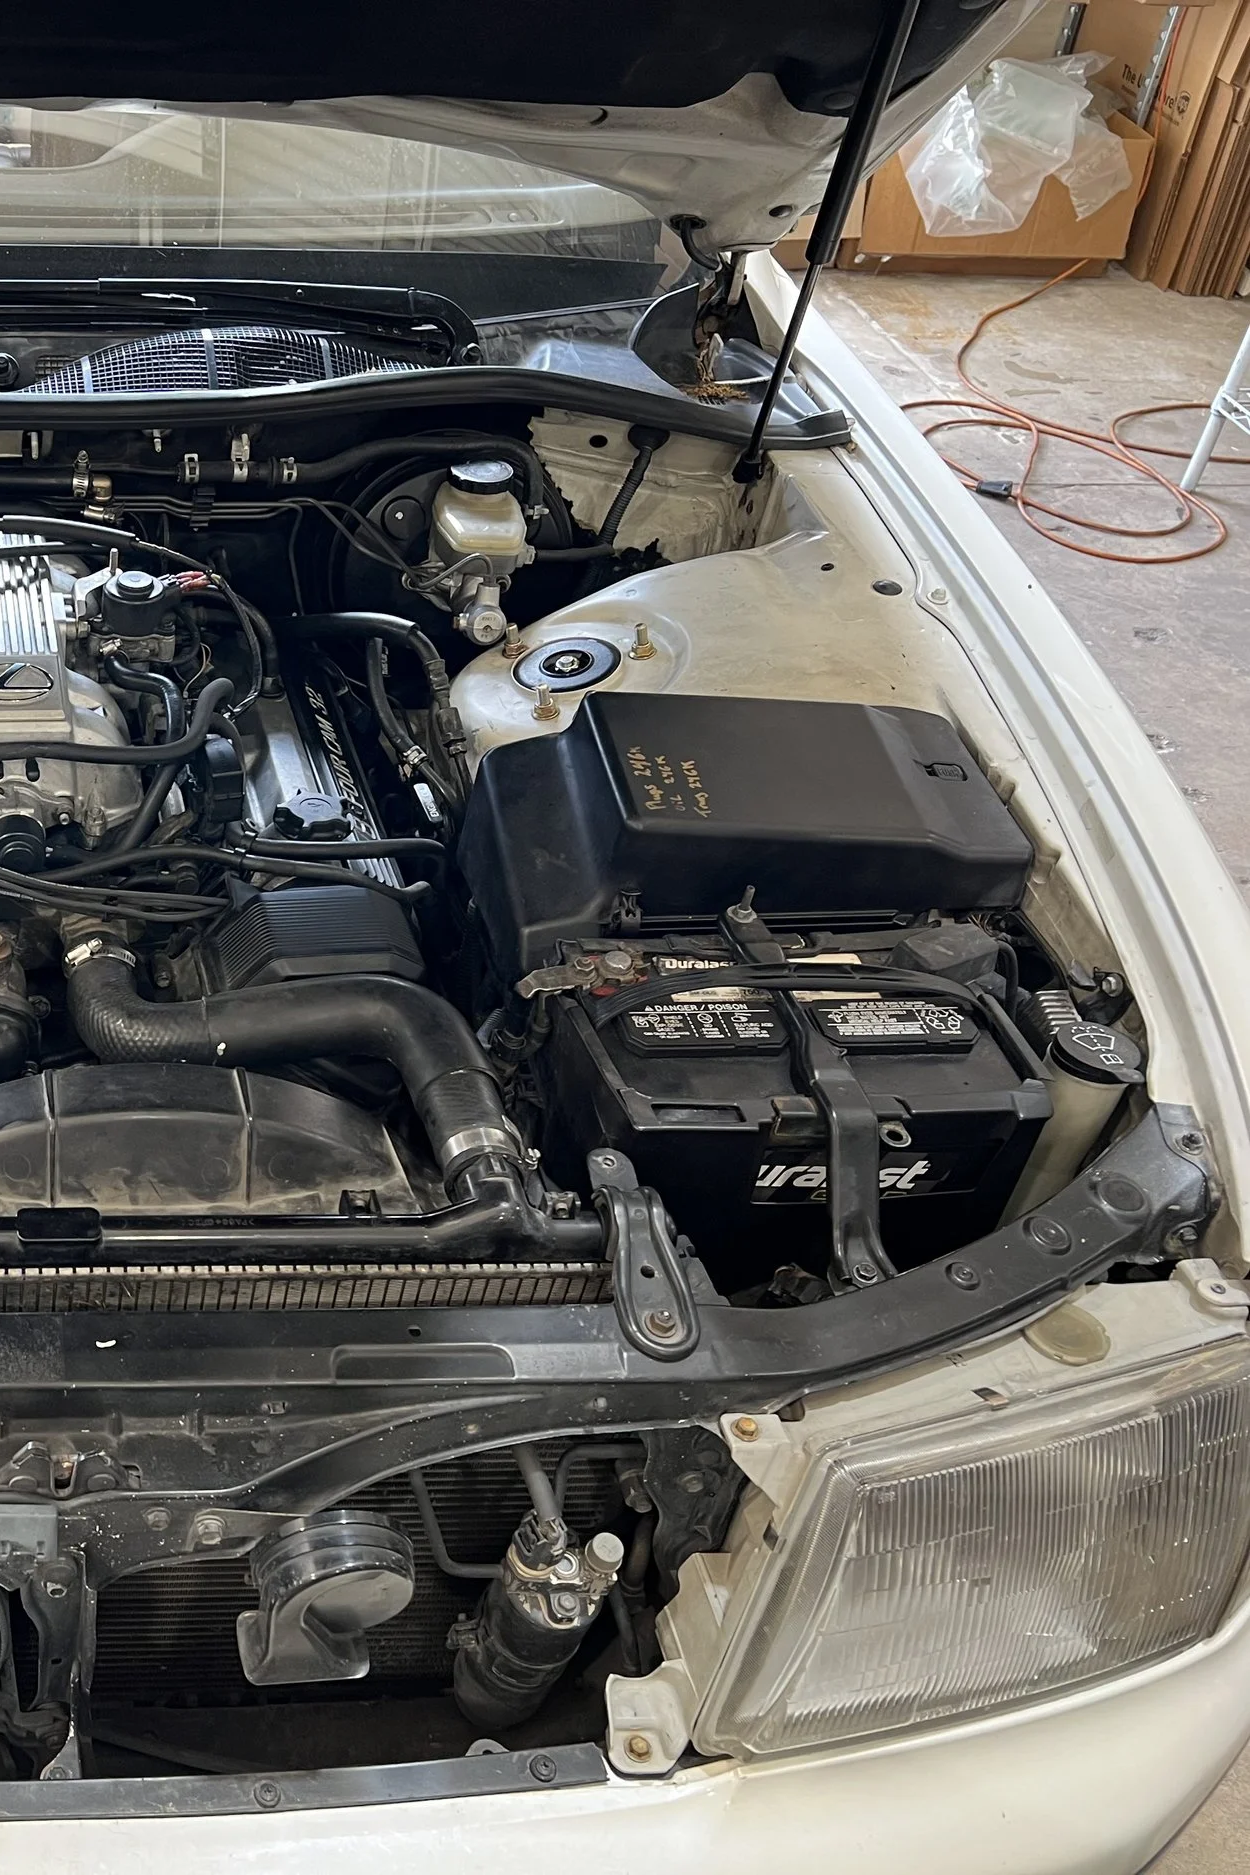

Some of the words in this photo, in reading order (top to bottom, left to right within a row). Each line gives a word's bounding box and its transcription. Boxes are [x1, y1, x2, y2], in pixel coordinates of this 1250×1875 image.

[1122, 63, 1137, 85] The
[305, 686, 327, 715] 32
[315, 714, 343, 757] CAM
[330, 754, 364, 809] FOUR
[654, 1004, 698, 1012] DANGER
[708, 1003, 748, 1012] POISON
